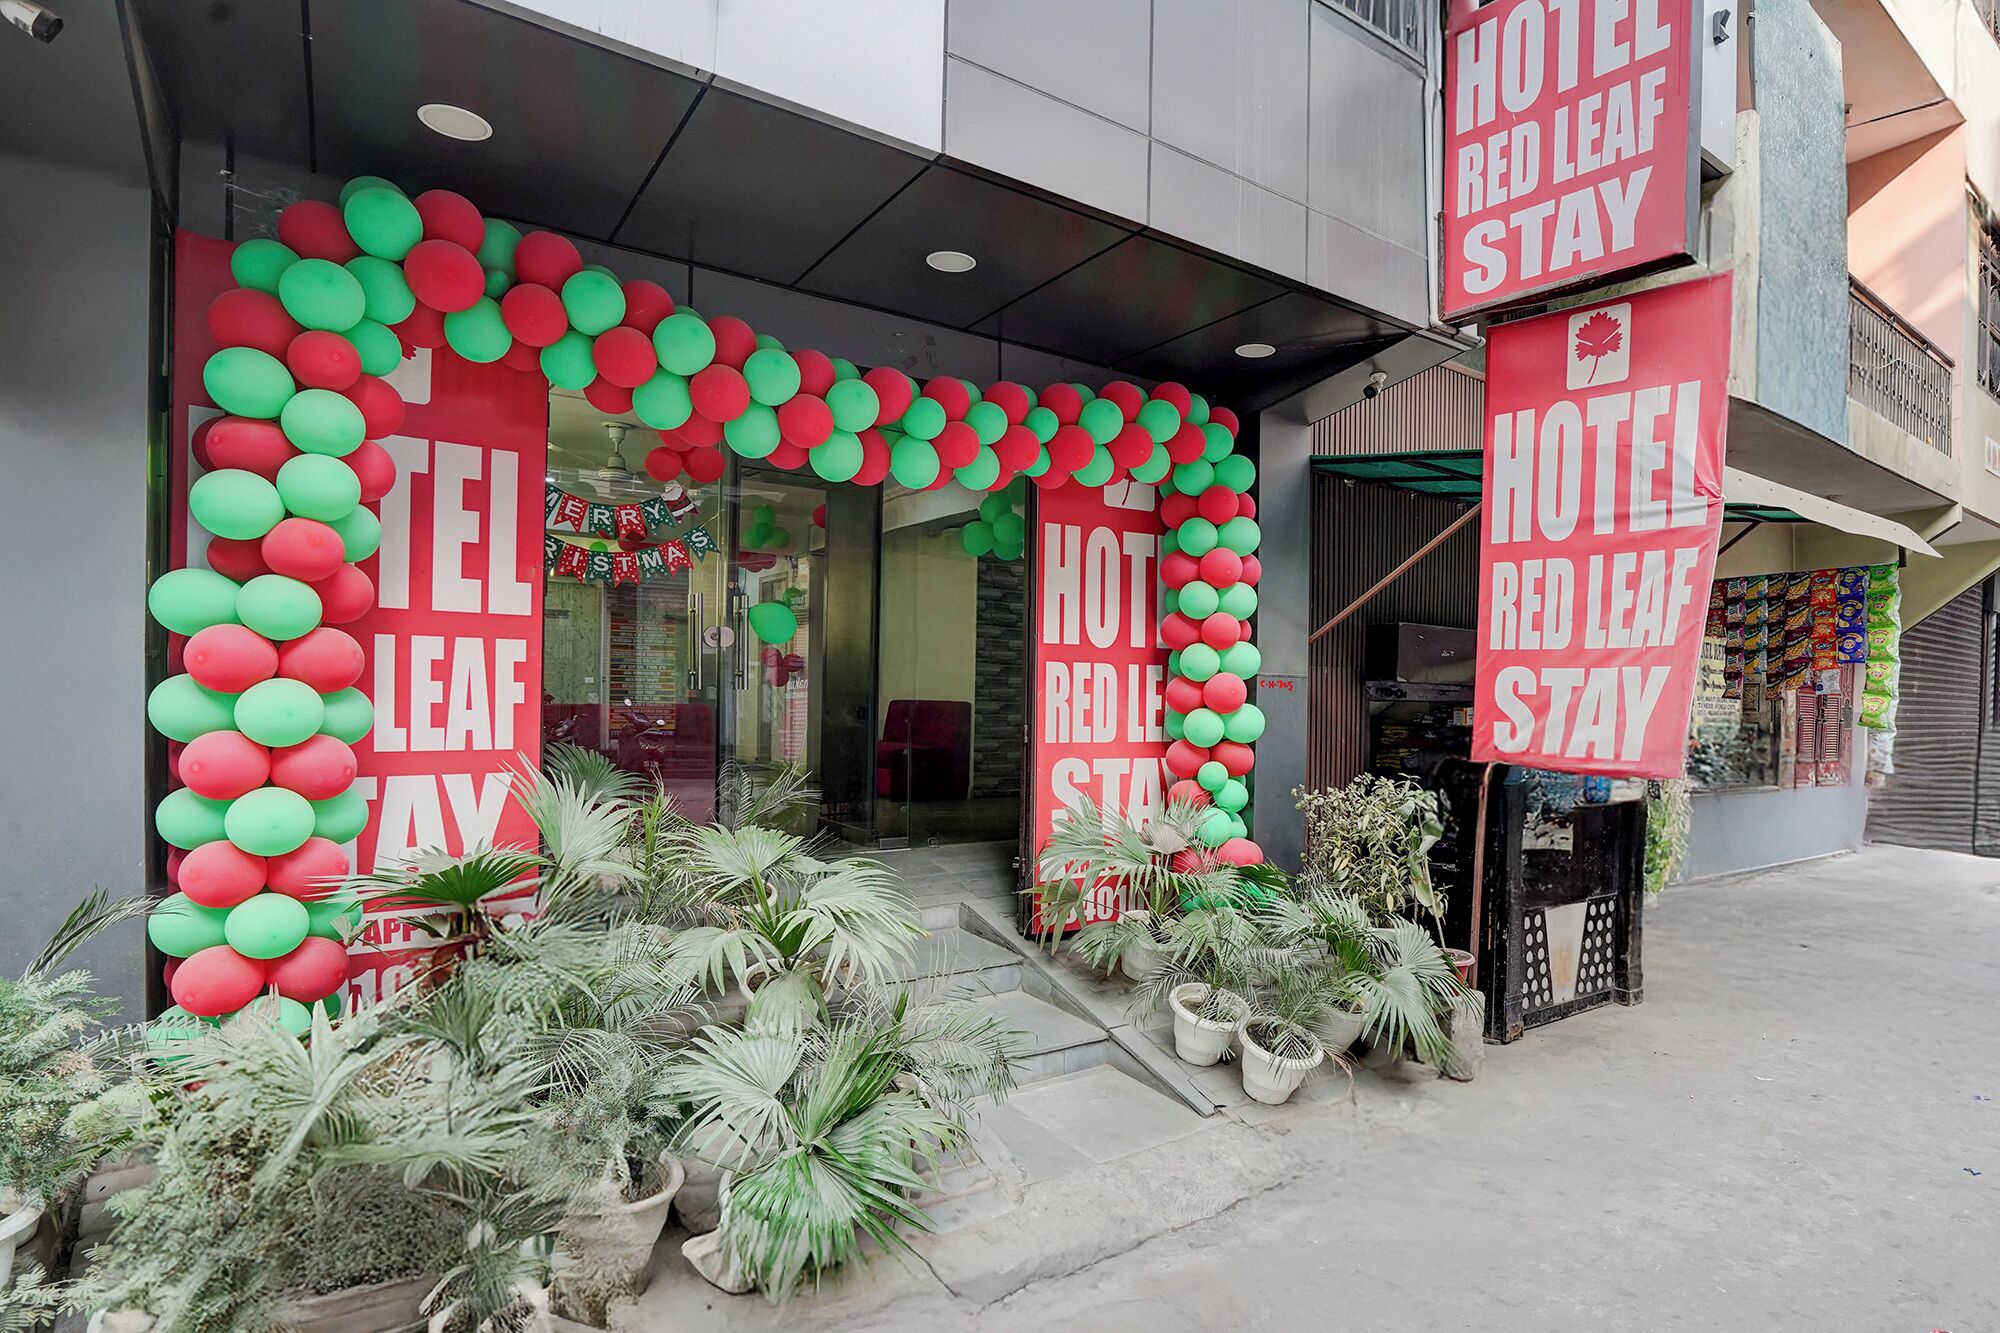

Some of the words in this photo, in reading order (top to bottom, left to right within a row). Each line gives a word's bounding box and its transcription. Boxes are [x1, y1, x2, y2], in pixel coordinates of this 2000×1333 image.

[1456, 0, 1671, 136] HOTEL
[1457, 121, 1540, 218] RED
[1553, 66, 1666, 184] LEAF
[1463, 166, 1654, 294] STAY
[377, 434, 532, 616] TEL
[1490, 380, 1708, 544] HOTEL
[545, 531, 708, 573] RISTMAS
[1044, 523, 1169, 649] HOT
[1489, 557, 1576, 650] RED
[1584, 547, 1700, 650] LEAF
[374, 634, 527, 752] LEAF
[1045, 661, 1118, 743] RED
[1127, 663, 1171, 743] LE
[1493, 665, 1673, 762] STAY
